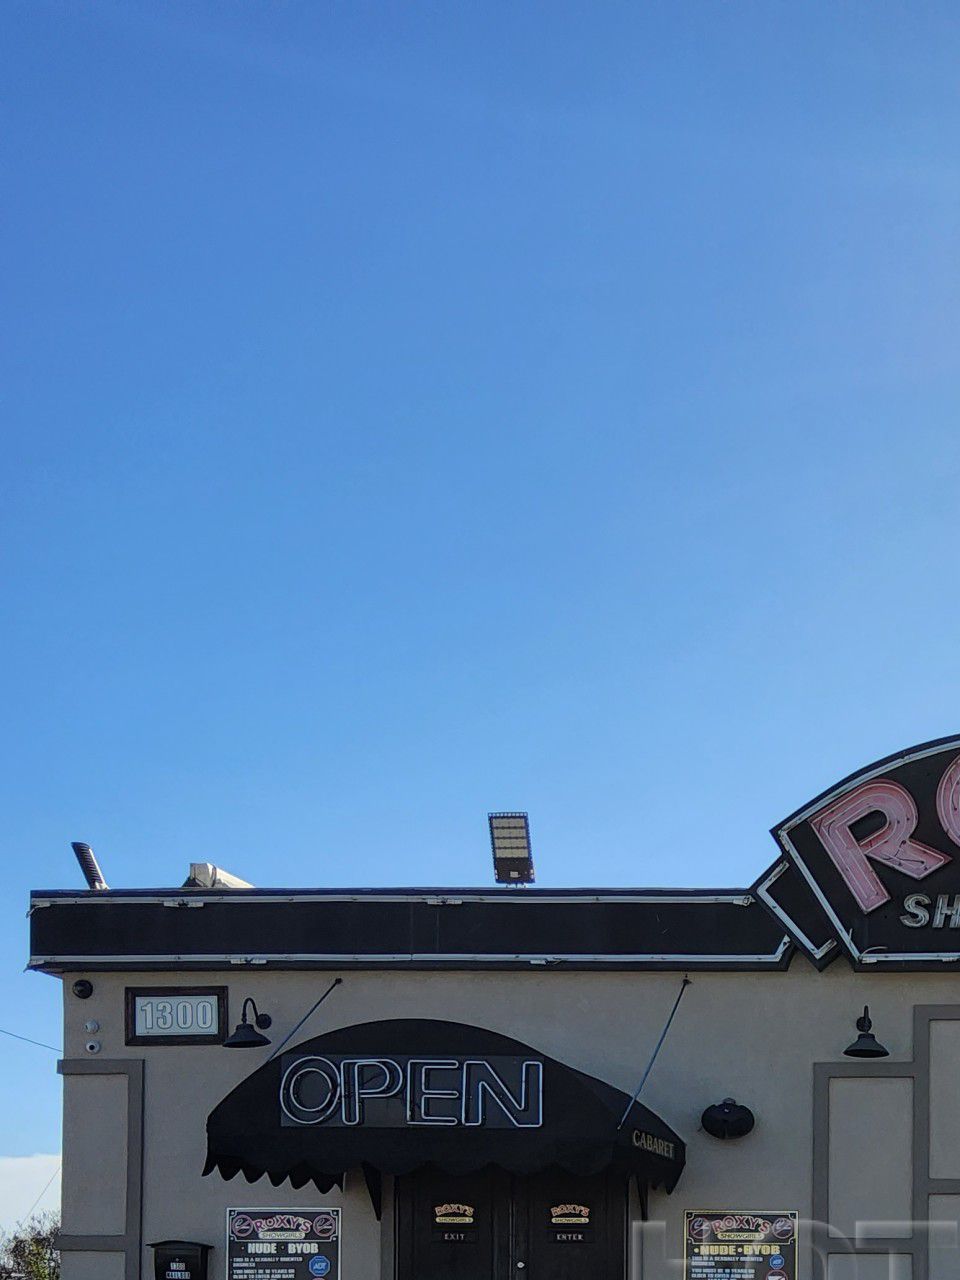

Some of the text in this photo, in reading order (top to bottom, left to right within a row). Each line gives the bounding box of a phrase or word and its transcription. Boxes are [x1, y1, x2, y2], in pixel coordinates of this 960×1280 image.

[140, 1001, 214, 1029] 1300
[279, 1056, 543, 1126] OPEN
[633, 1130, 674, 1158] CABARET
[434, 1203, 474, 1217] ROXY'S
[550, 1204, 590, 1217] ROXY'S
[253, 1214, 313, 1234] ROXY'S
[711, 1215, 772, 1235] ROXY'S
[247, 1243, 319, 1254] NUDE BYOB
[700, 1245, 780, 1255] NUDE BYOB
